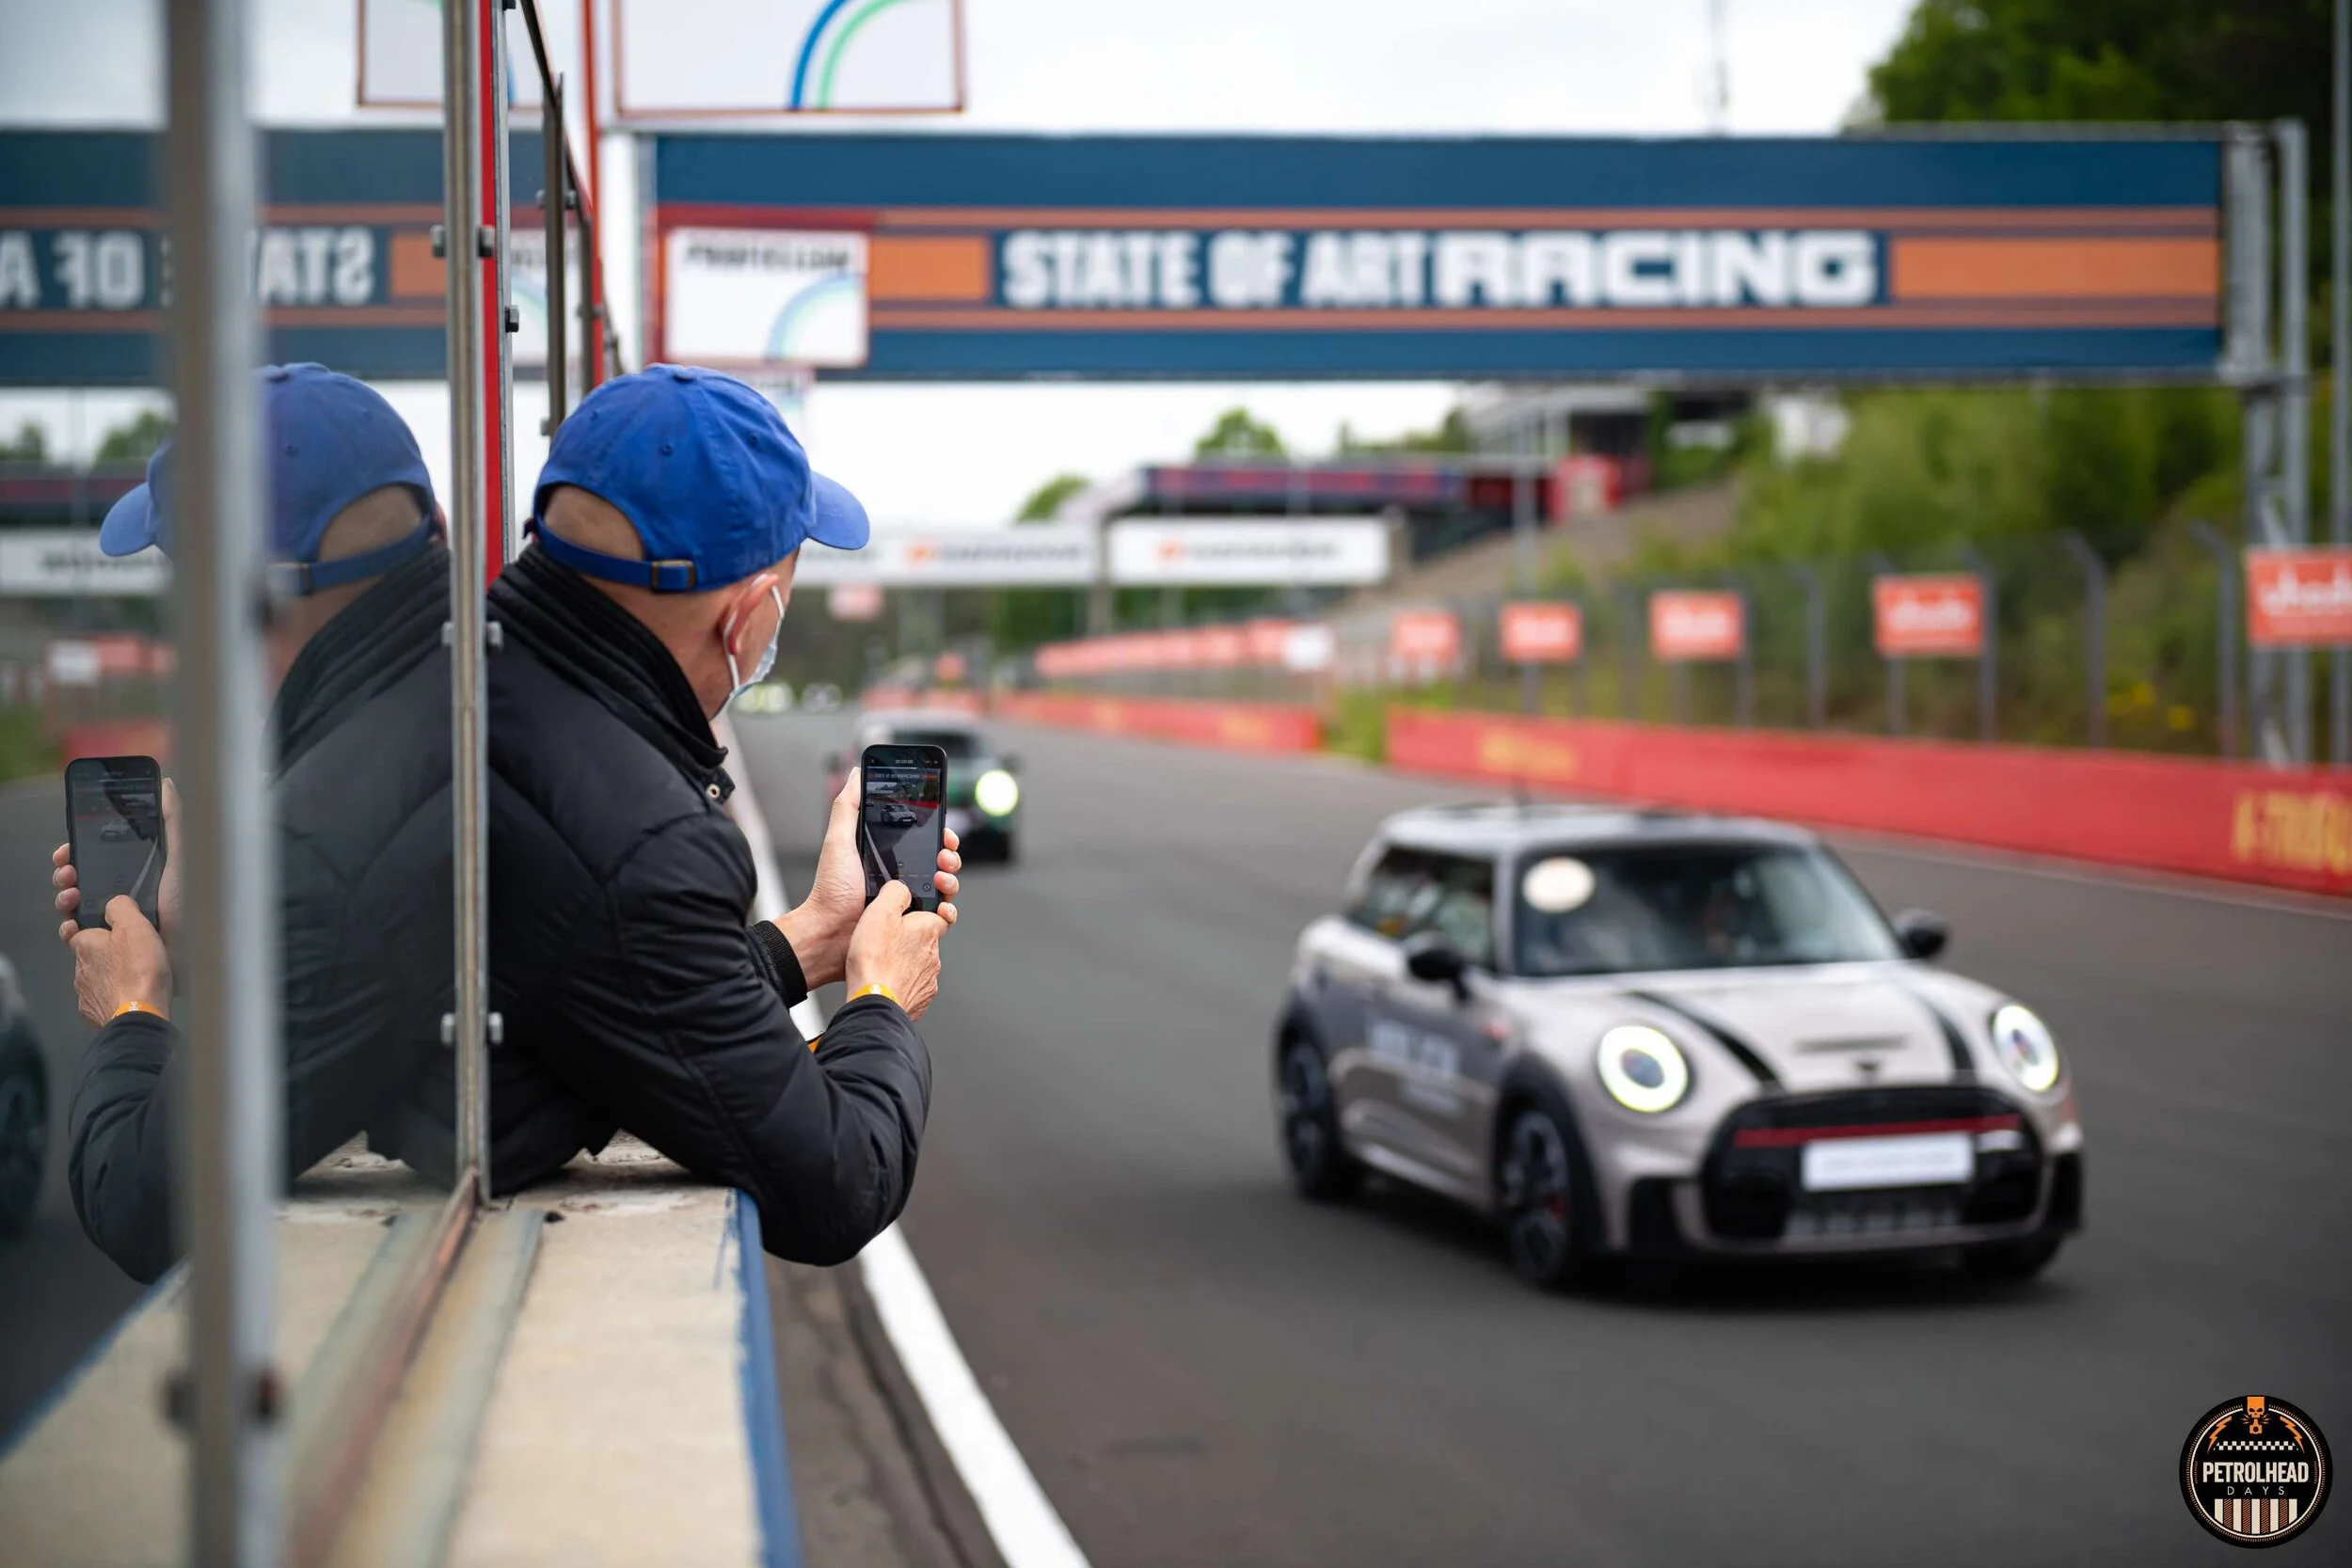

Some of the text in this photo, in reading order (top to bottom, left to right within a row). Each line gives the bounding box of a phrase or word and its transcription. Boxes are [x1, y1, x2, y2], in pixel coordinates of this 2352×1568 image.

[1003, 229, 1200, 308] STATE
[1209, 229, 1295, 308] OF
[1432, 229, 1877, 308] RACING
